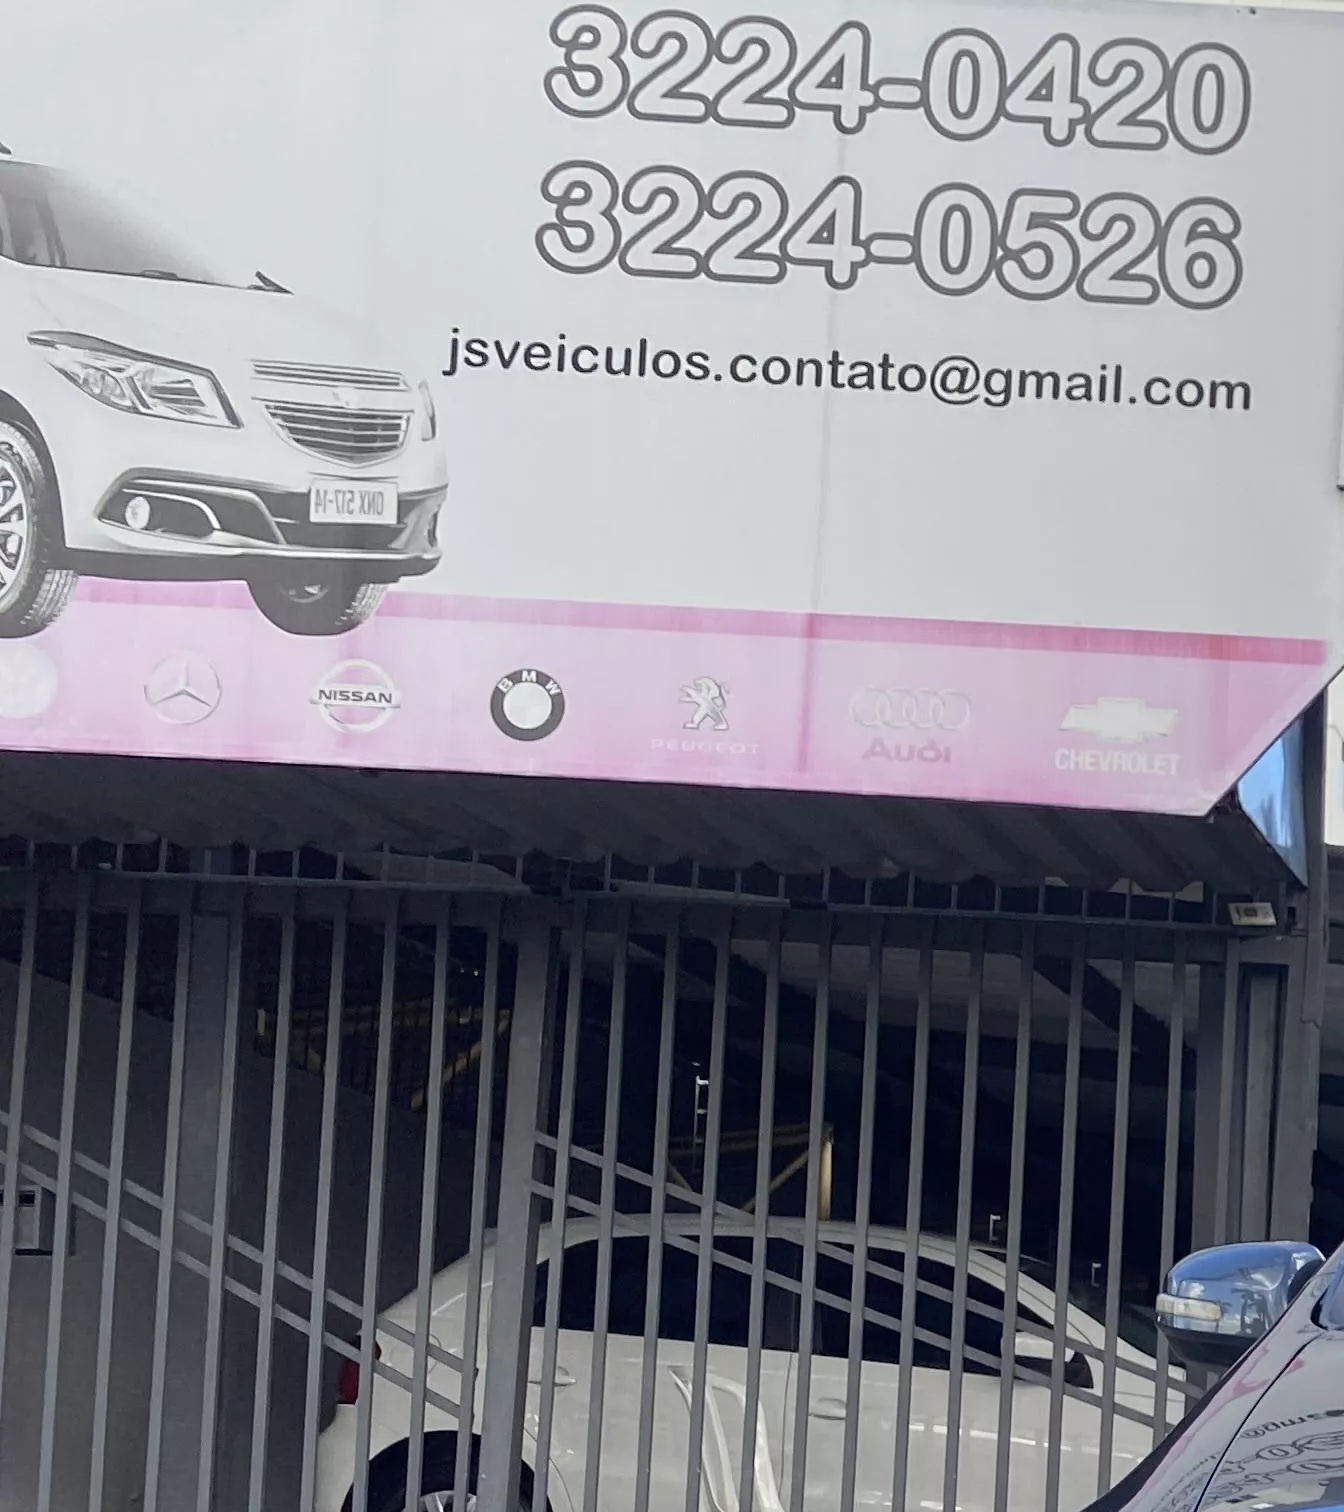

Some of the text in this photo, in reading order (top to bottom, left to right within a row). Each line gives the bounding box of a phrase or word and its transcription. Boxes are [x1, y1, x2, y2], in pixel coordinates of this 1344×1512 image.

[543, 3, 1252, 155] 3224-0420
[536, 159, 1243, 311] 3224-0526
[442, 327, 1252, 411] jsveiculos.contato@gmail.com
[318, 688, 393, 704] NISSAN
[497, 669, 561, 696] BMW
[861, 736, 952, 764] Audi
[1055, 747, 1180, 775] CHEVROLET
